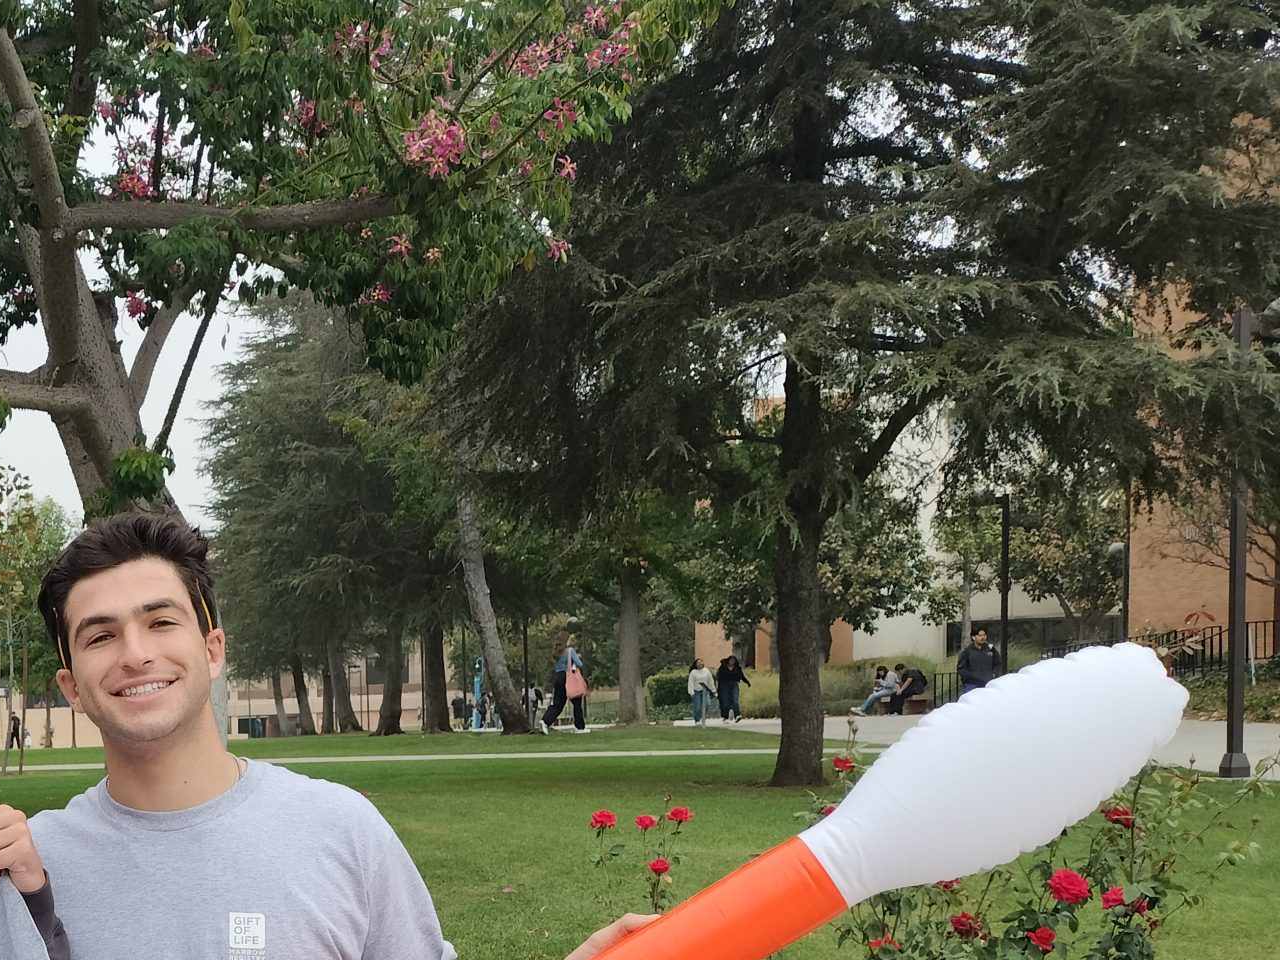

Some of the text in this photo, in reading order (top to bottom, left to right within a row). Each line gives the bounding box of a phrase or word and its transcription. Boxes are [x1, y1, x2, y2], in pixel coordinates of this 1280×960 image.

[234, 917, 261, 926] GIFT
[234, 926, 251, 935] OF
[234, 936, 260, 945] LIFE
